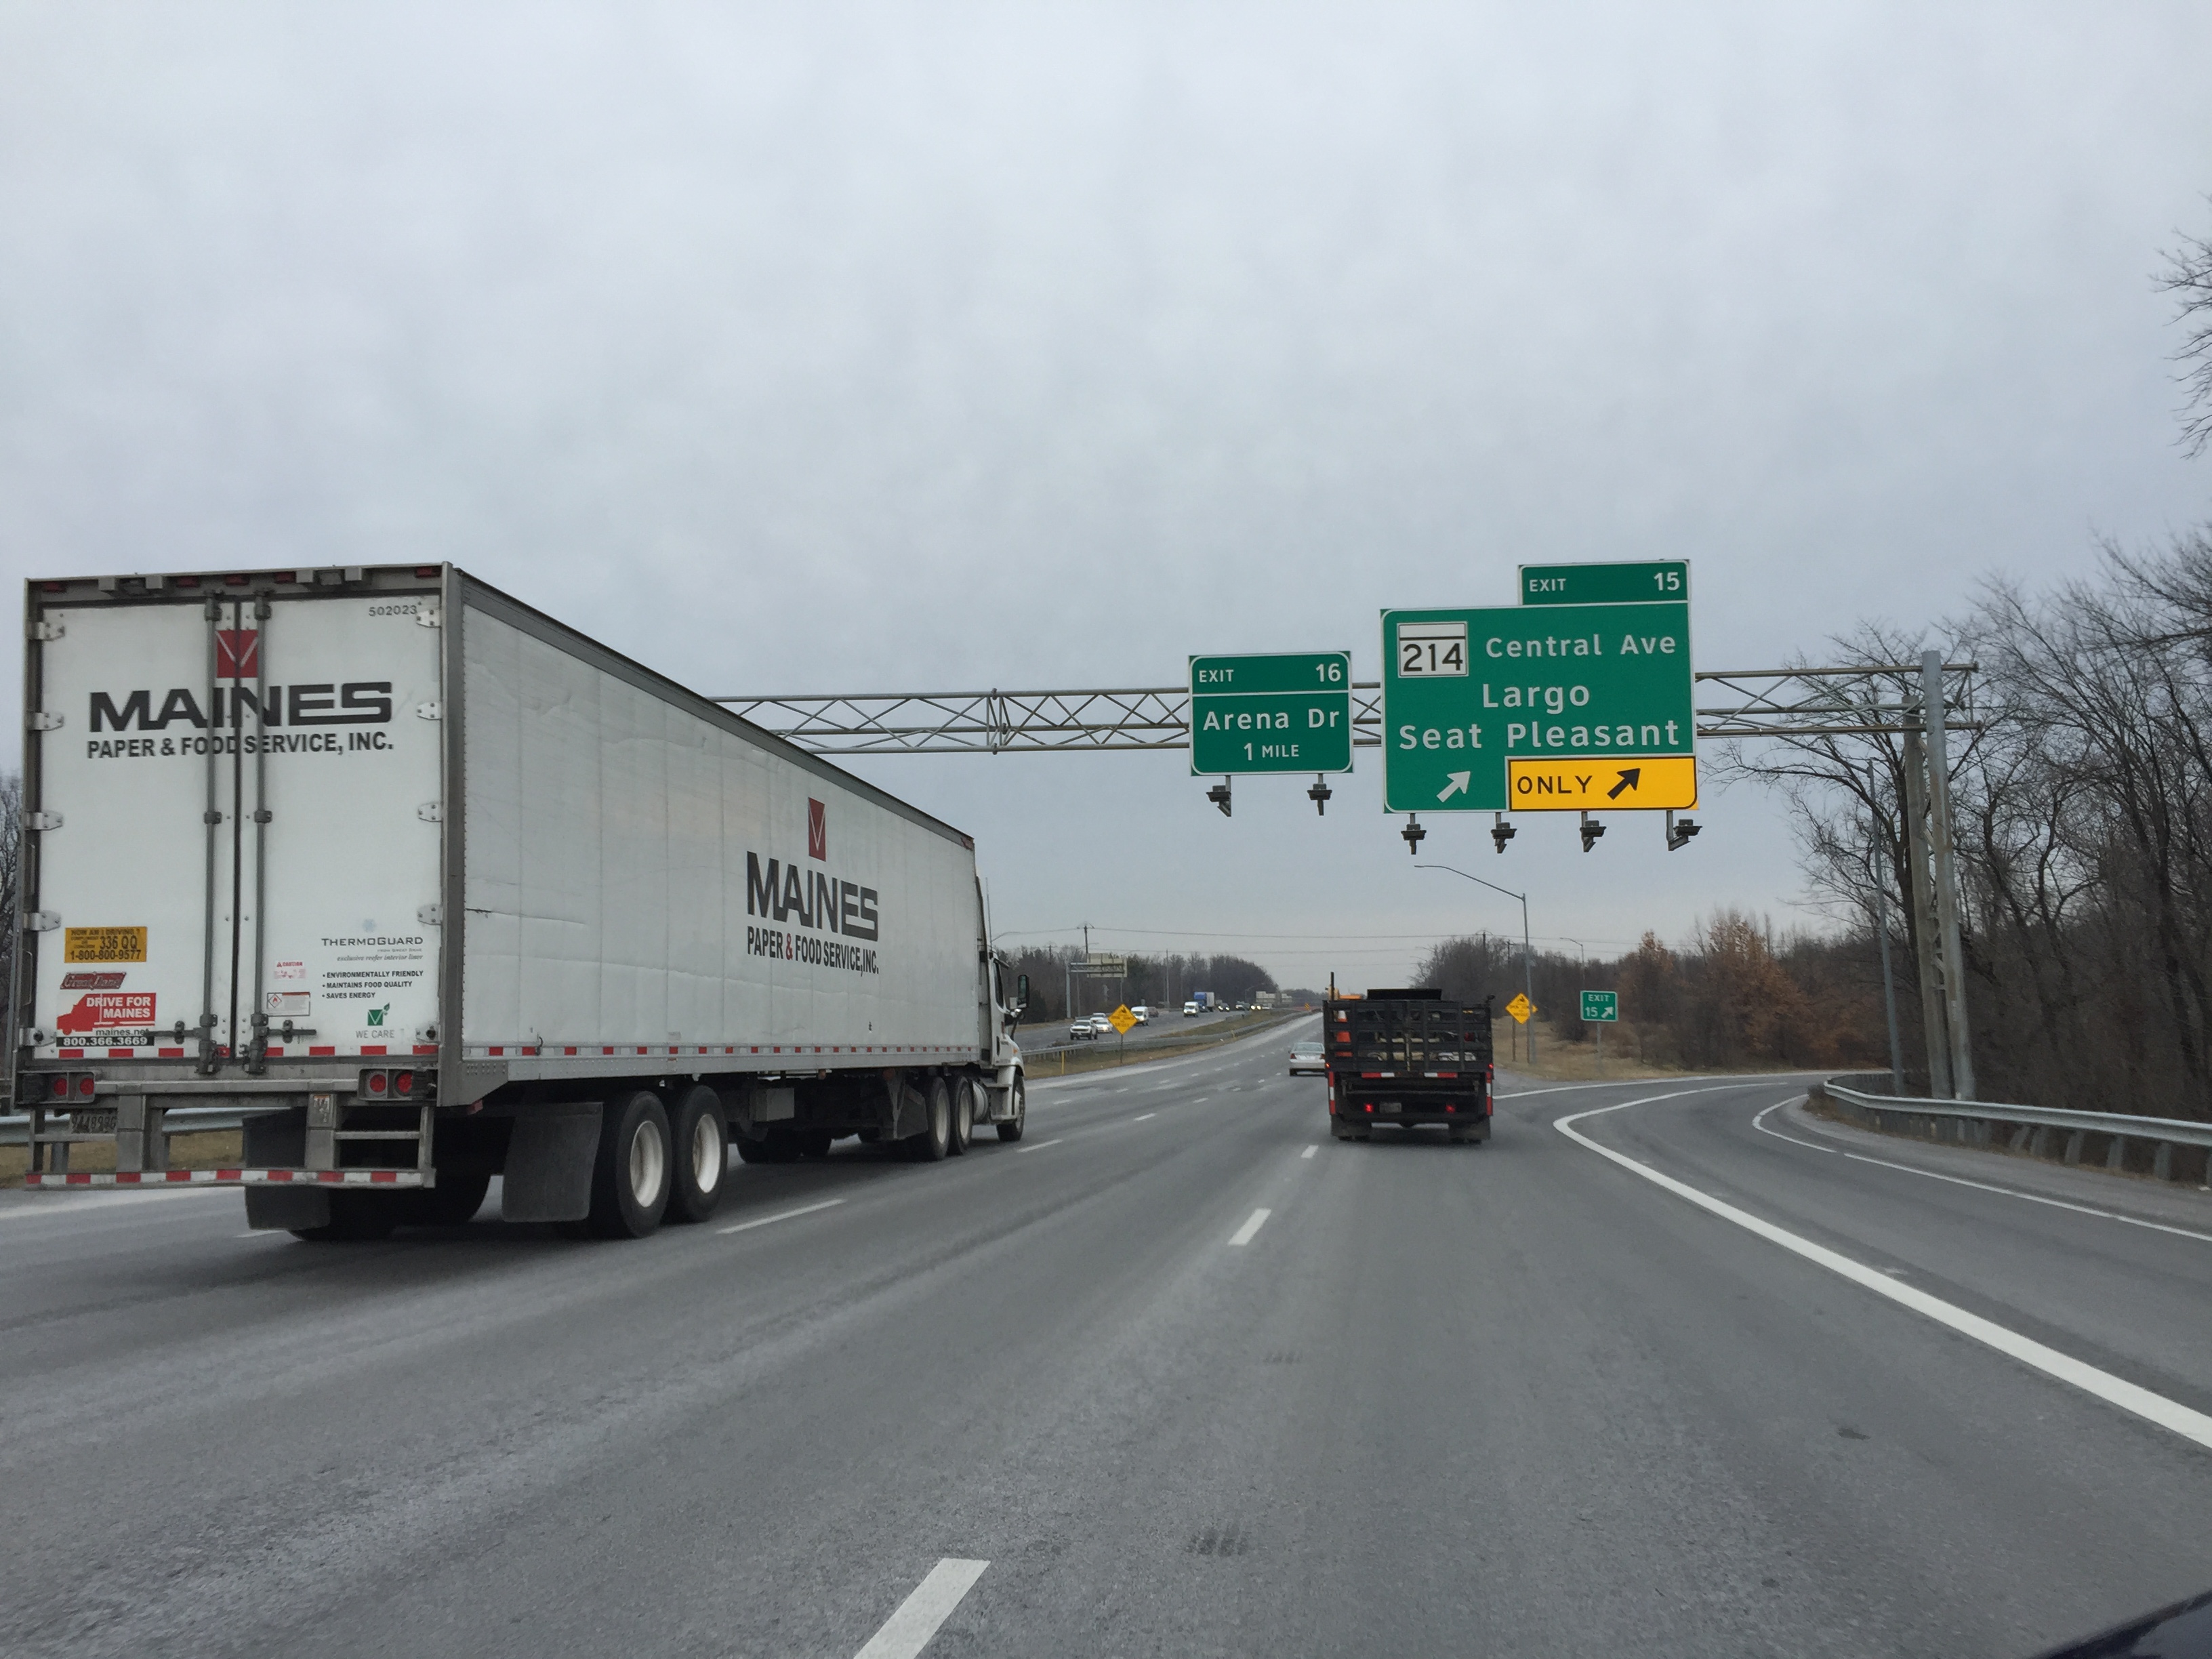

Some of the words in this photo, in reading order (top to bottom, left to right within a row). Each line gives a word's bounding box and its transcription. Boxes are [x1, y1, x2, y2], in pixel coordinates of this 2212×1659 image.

[1529, 579, 1567, 592] EXIT
[1654, 572, 1681, 591] 15
[369, 605, 417, 617] 502023
[1486, 634, 1602, 658] Central
[1620, 635, 1677, 655] Ave
[1403, 642, 1463, 672] 214
[1199, 669, 1234, 682] EXIT
[1315, 663, 1341, 682] 16
[89, 681, 392, 733] MAINES
[1483, 683, 1590, 714] Largo
[1203, 711, 1289, 731] Arena
[1308, 708, 1339, 729] Dr
[87, 739, 155, 759] PAPER
[160, 737, 176, 756] &
[348, 731, 394, 751] INC.
[1399, 723, 1482, 750] Seat
[1507, 720, 1679, 747] Pleasant
[1244, 743, 1252, 761] 1
[1262, 745, 1299, 758] MILE
[1517, 775, 1593, 795] ONLY
[747, 851, 879, 942] MAINES
[100, 936, 119, 949] 336
[747, 926, 784, 960] PAPER
[785, 933, 793, 960] &
[795, 935, 822, 965] FOOD
[70, 949, 142, 960] 1-800-800-9577
[86, 997, 123, 1007] DRIVE
[126, 996, 151, 1006] FOR
[1585, 1006, 1598, 1017] 15
[103, 1008, 150, 1019] MAINES
[63, 1037, 148, 1046] 800.366.3669
[356, 1030, 368, 1038] WE
[371, 1029, 394, 1038] CARE
